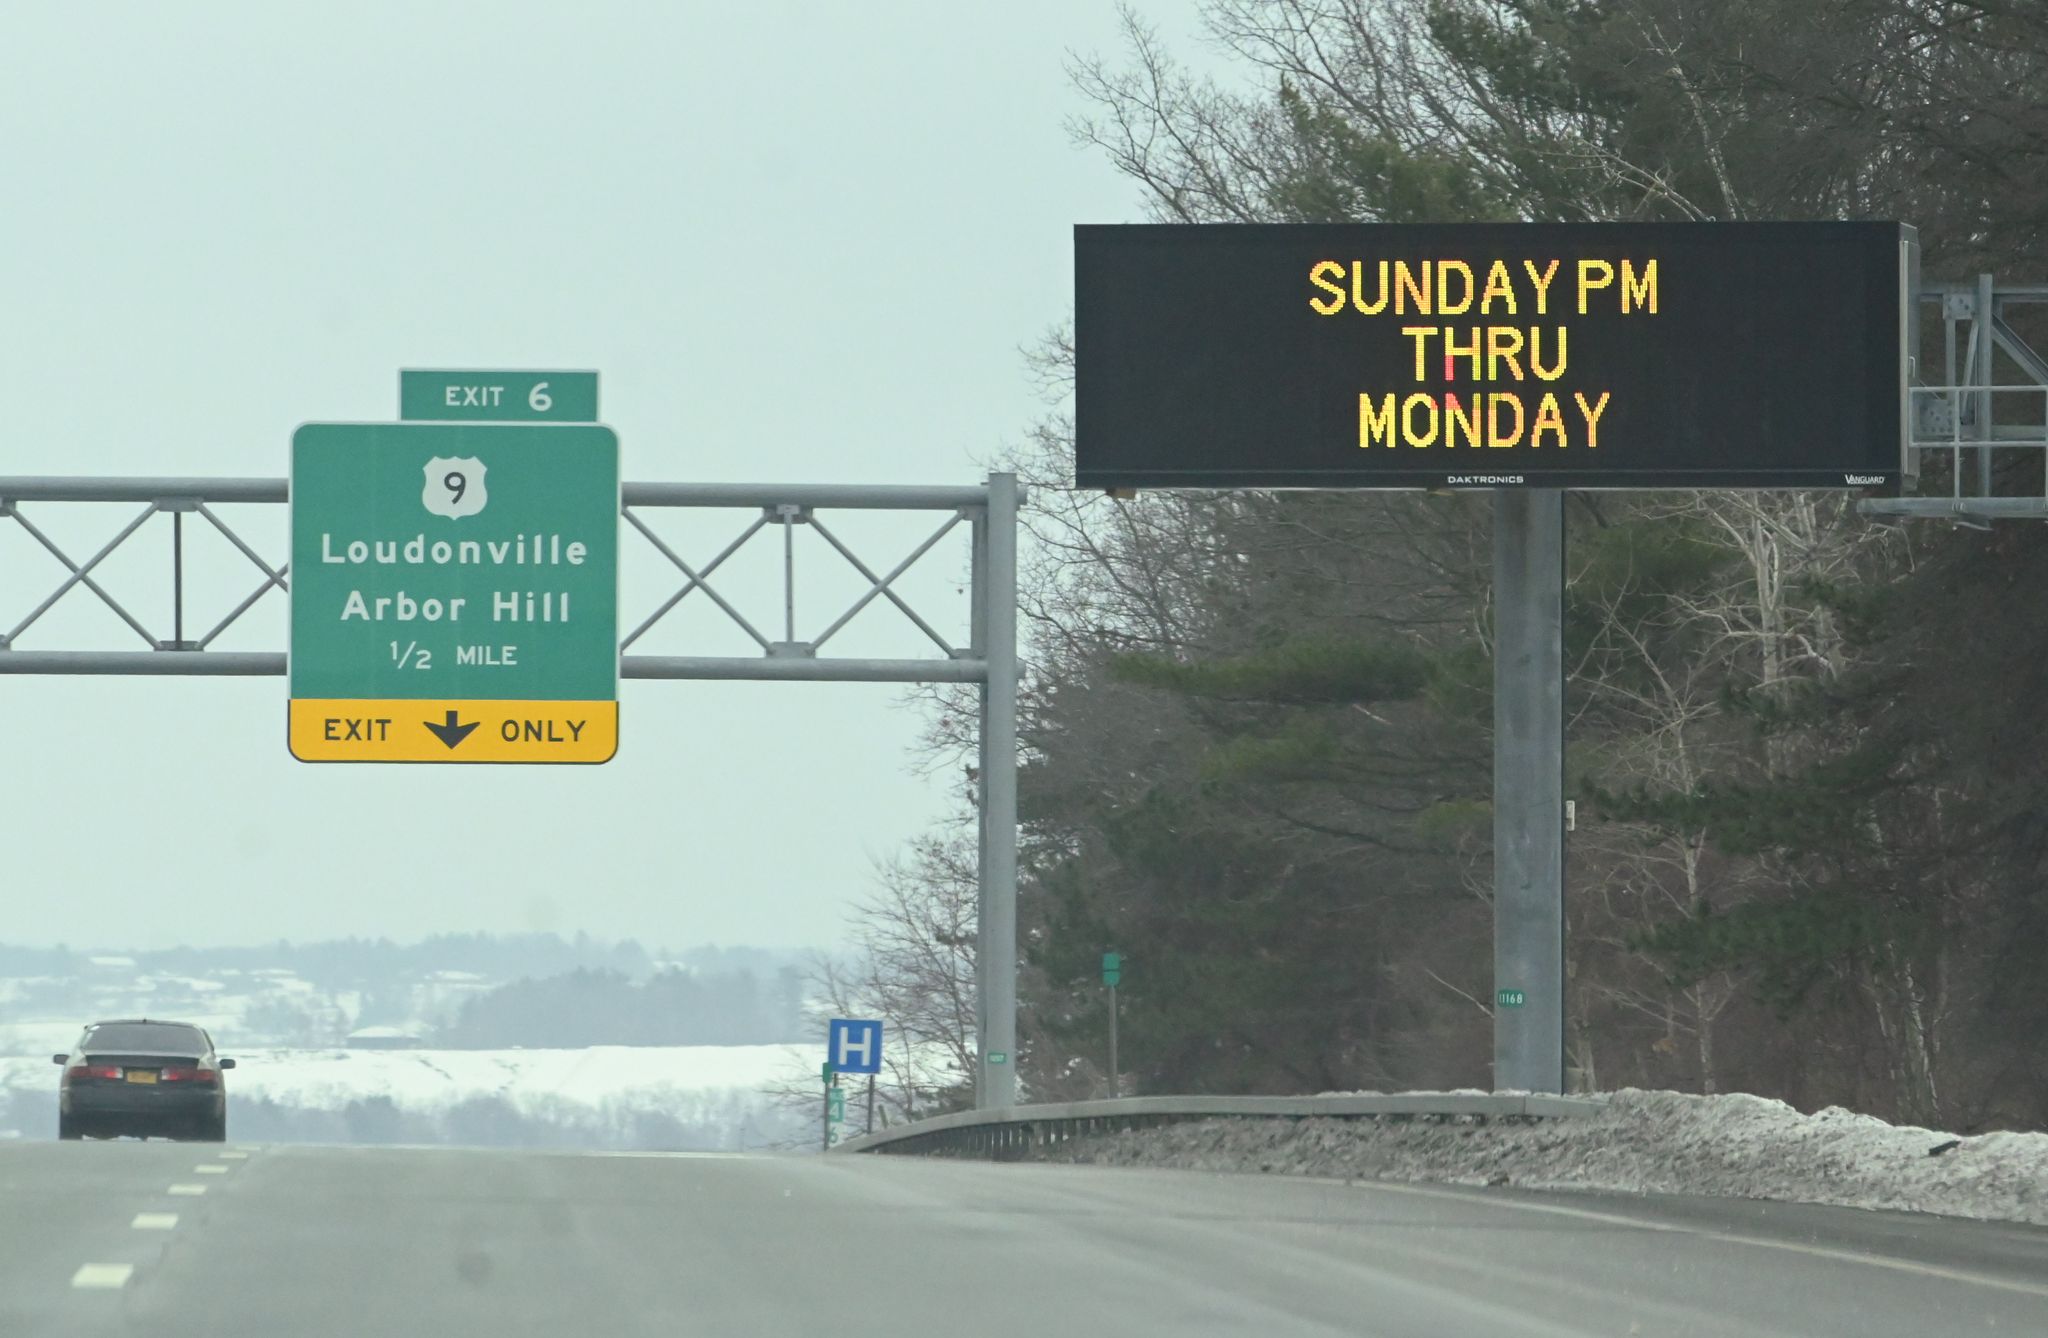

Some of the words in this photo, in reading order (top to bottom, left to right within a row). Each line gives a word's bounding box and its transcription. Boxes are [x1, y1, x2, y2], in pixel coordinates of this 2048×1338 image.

[1309, 259, 1560, 315] SUNDAY
[1577, 259, 1658, 315] PM
[1402, 326, 1567, 381] THRU
[446, 386, 504, 406] EXIT
[528, 382, 552, 412] 6
[1359, 392, 1610, 448] MONDAY
[443, 471, 467, 505] 9
[1447, 475, 1524, 484] DAKTRONICS
[322, 533, 588, 565] Loudonville
[340, 590, 466, 622] Arbor
[493, 591, 570, 623] Hill
[456, 645, 518, 666] MILE
[324, 718, 392, 742] EXIT
[500, 719, 587, 743] ONLY
[838, 1026, 872, 1066] H
